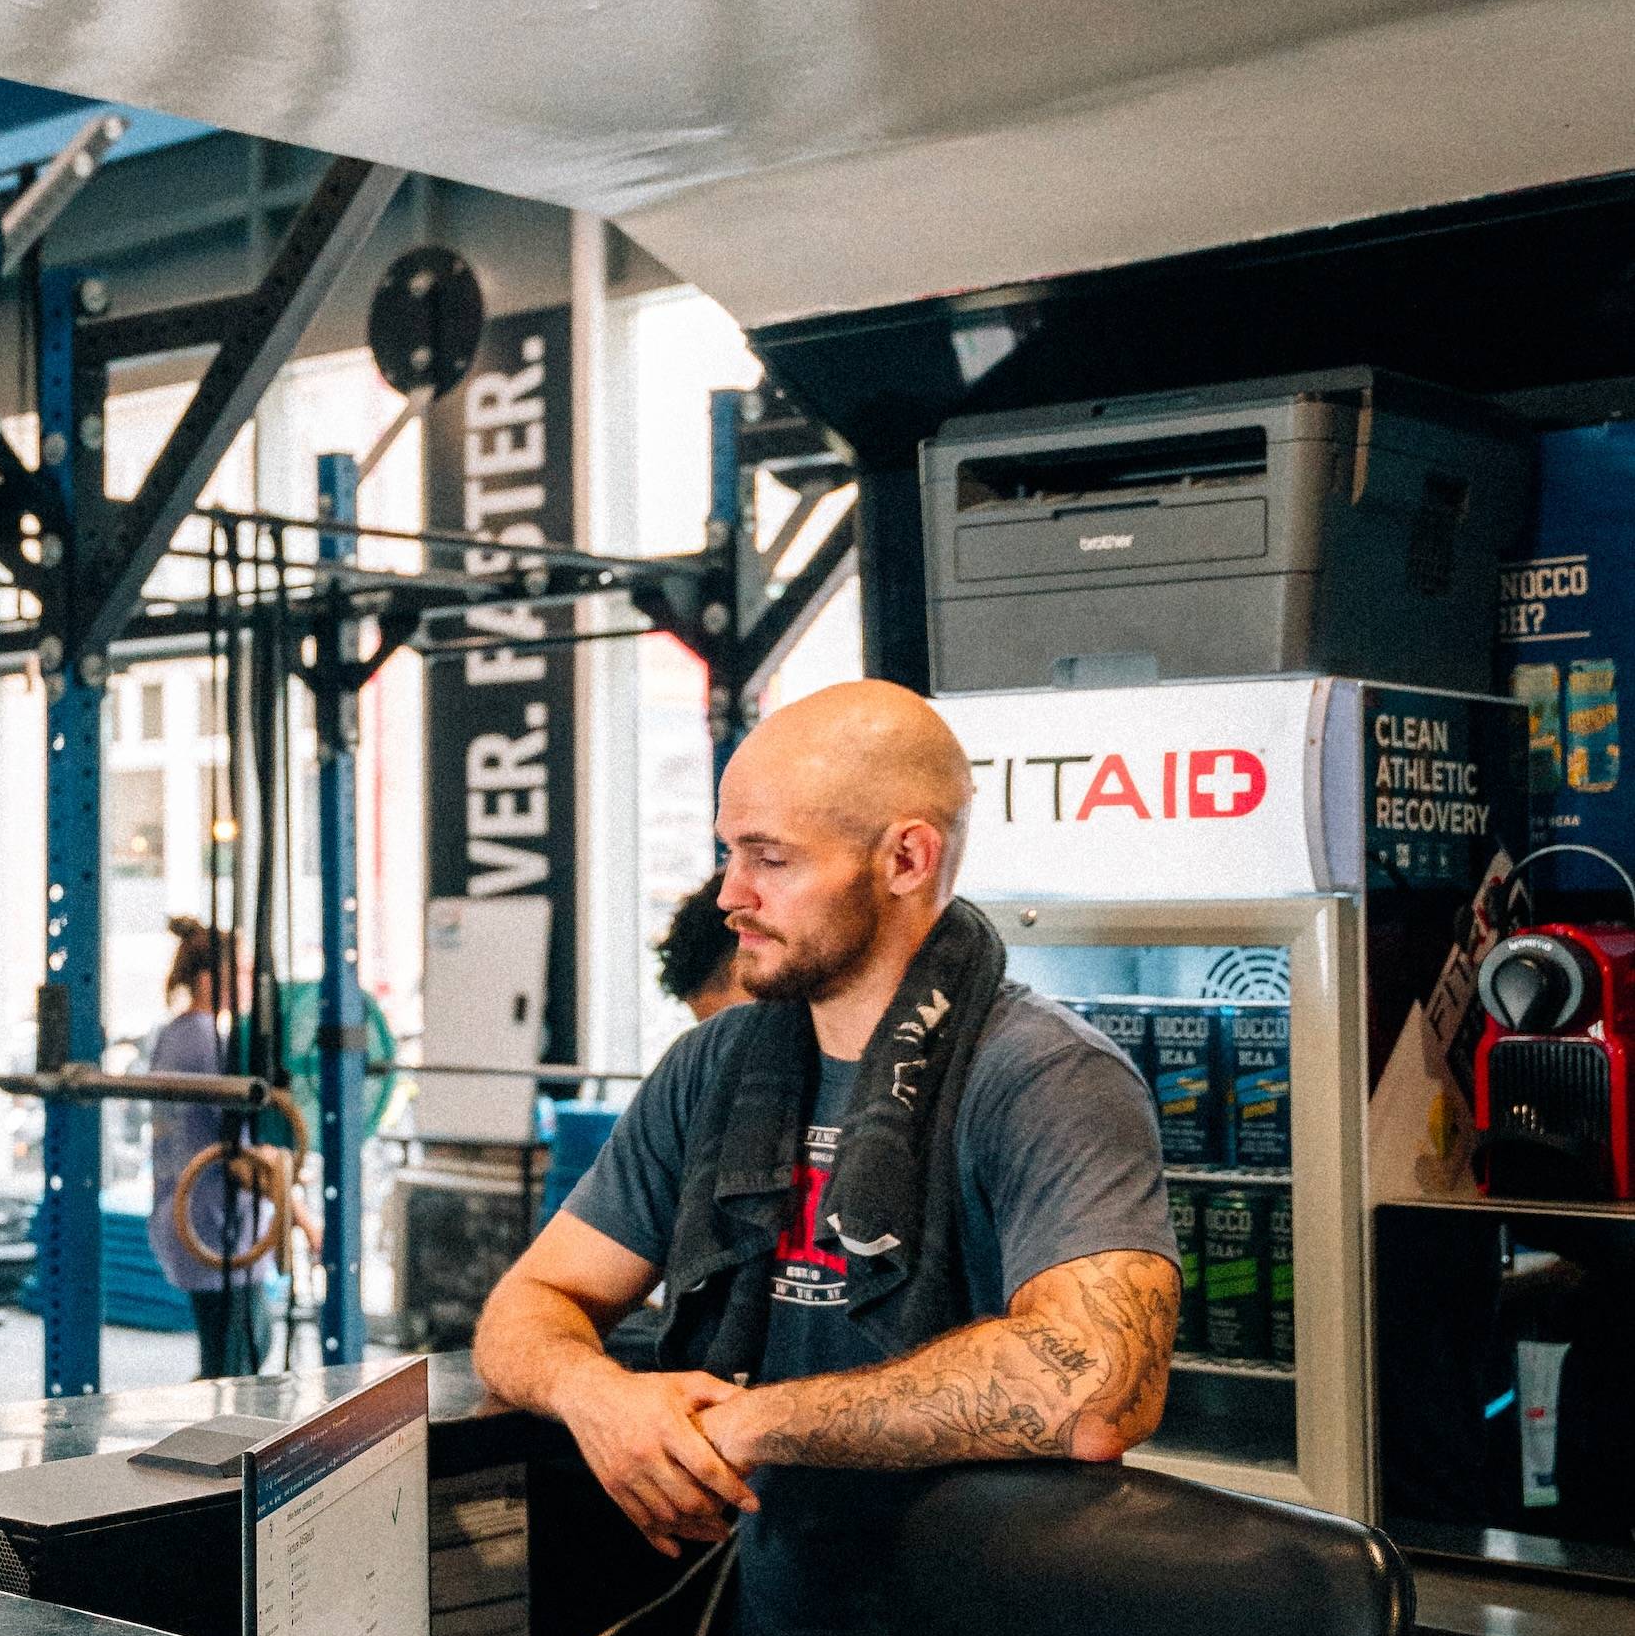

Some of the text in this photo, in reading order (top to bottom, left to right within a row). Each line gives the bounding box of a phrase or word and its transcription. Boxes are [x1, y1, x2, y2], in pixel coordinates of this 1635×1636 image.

[1375, 714, 1449, 753] CLEAN
[971, 749, 1267, 823] ITAID
[1376, 754, 1479, 795] ATHLETIC
[1376, 795, 1491, 836] RECOVERY
